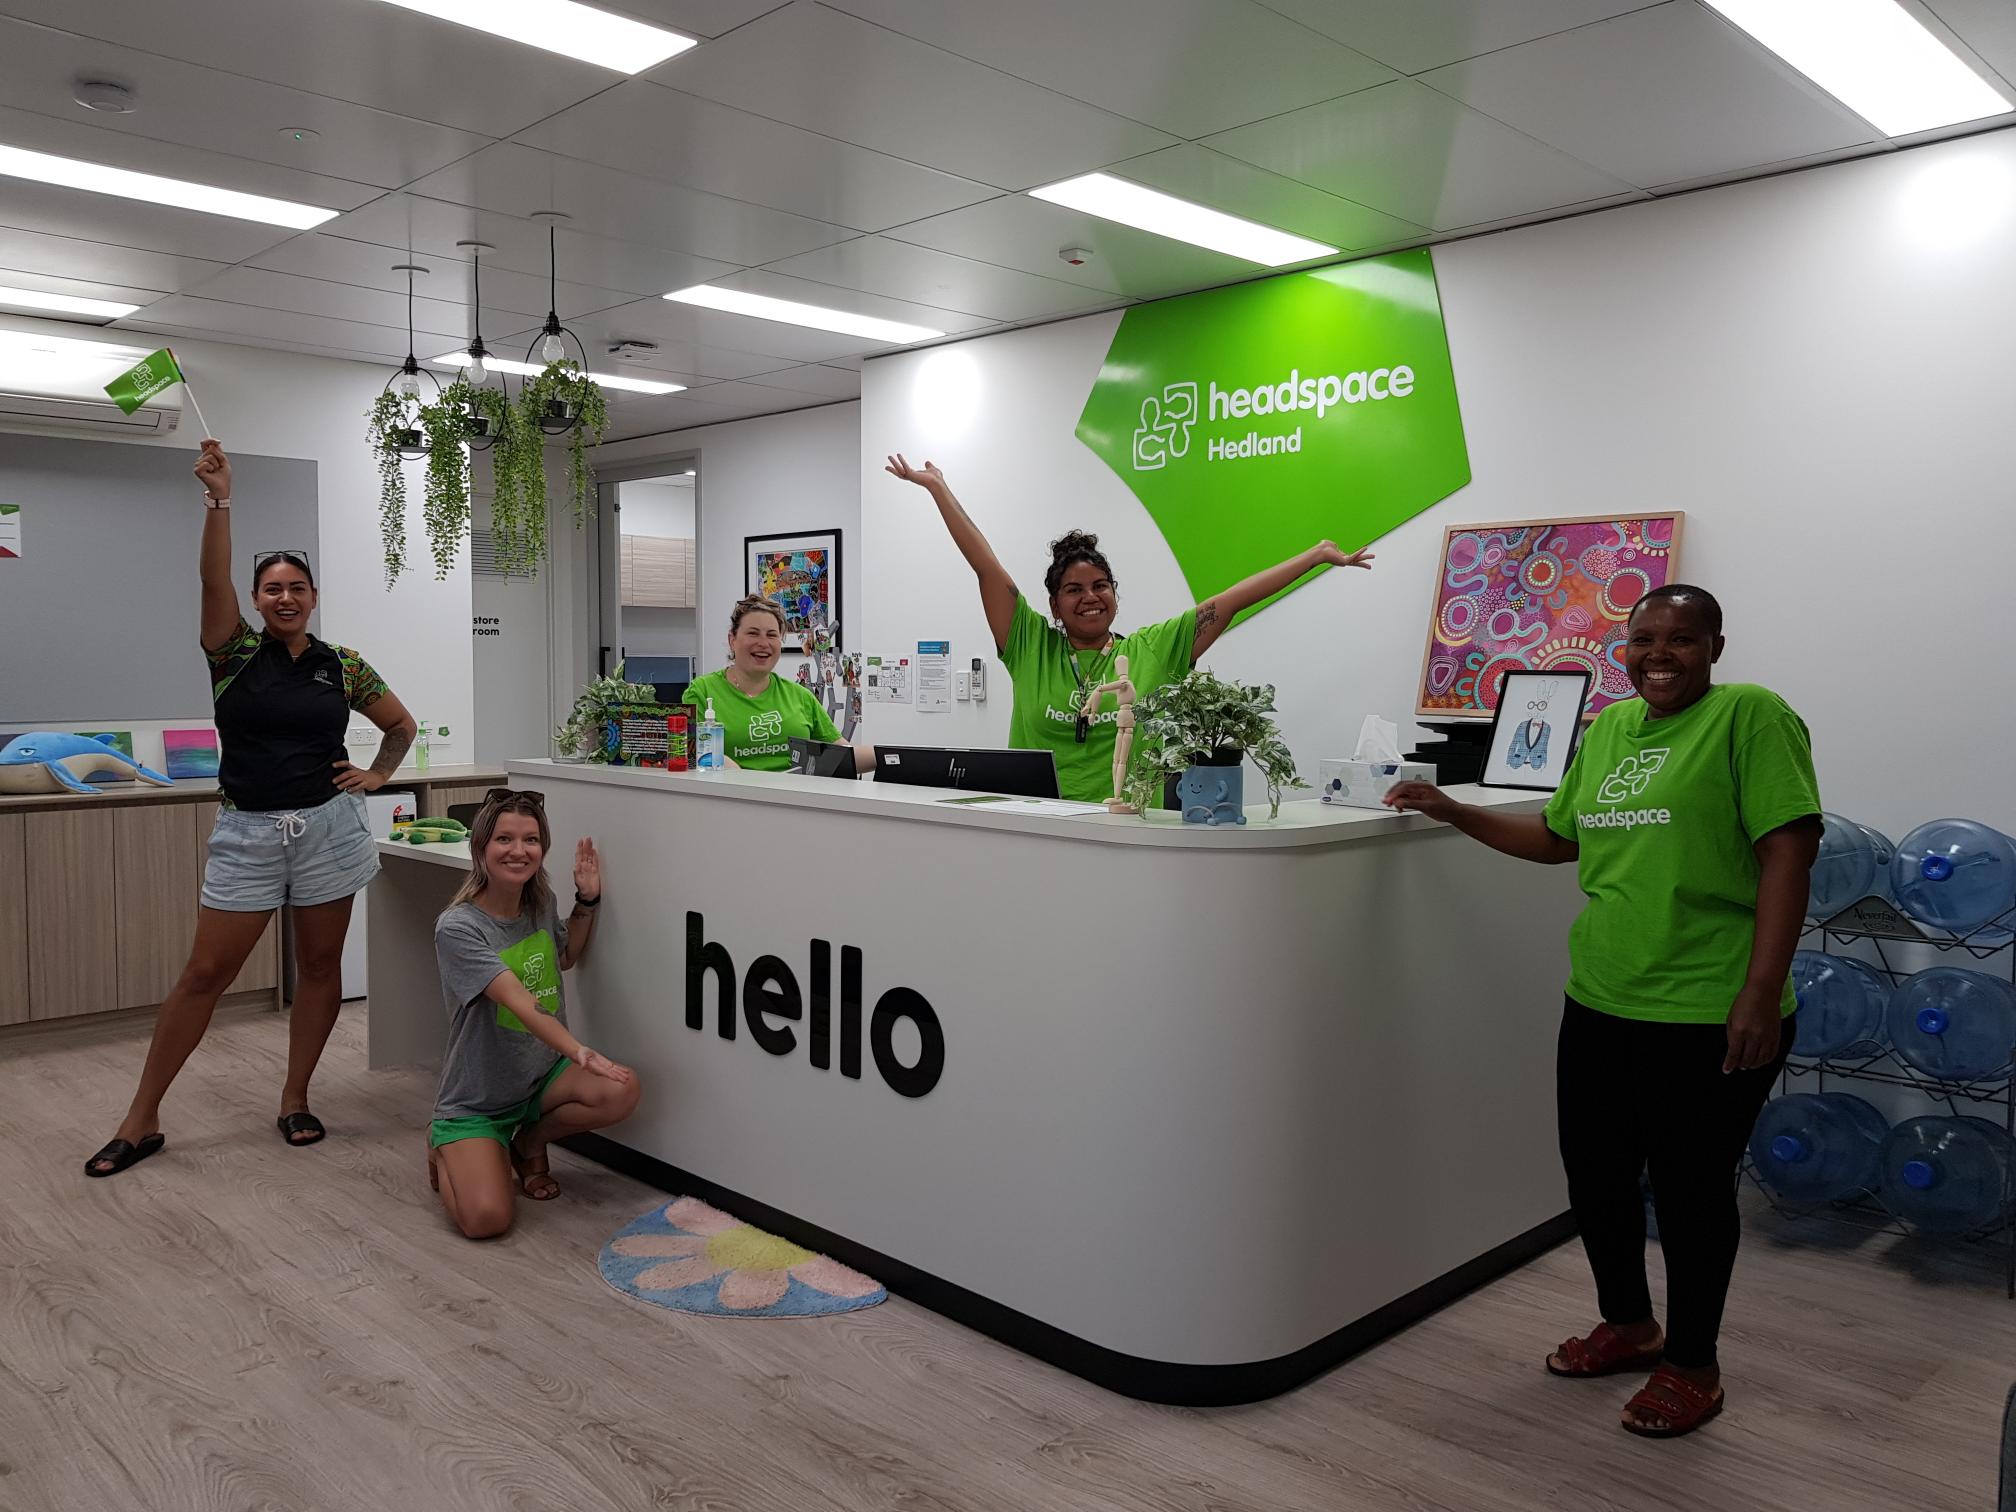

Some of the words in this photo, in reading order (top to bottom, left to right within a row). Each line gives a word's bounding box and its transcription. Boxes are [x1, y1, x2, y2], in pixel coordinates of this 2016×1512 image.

[133, 376, 171, 401] headspace
[1208, 365, 1415, 421] headspace
[1207, 426, 1301, 461] Hedland
[472, 628, 500, 636] room
[473, 616, 500, 625] store
[1045, 704, 1118, 727] heapac
[734, 742, 789, 758] headspa
[1576, 806, 1671, 831] headspace
[685, 911, 945, 1098] hello
